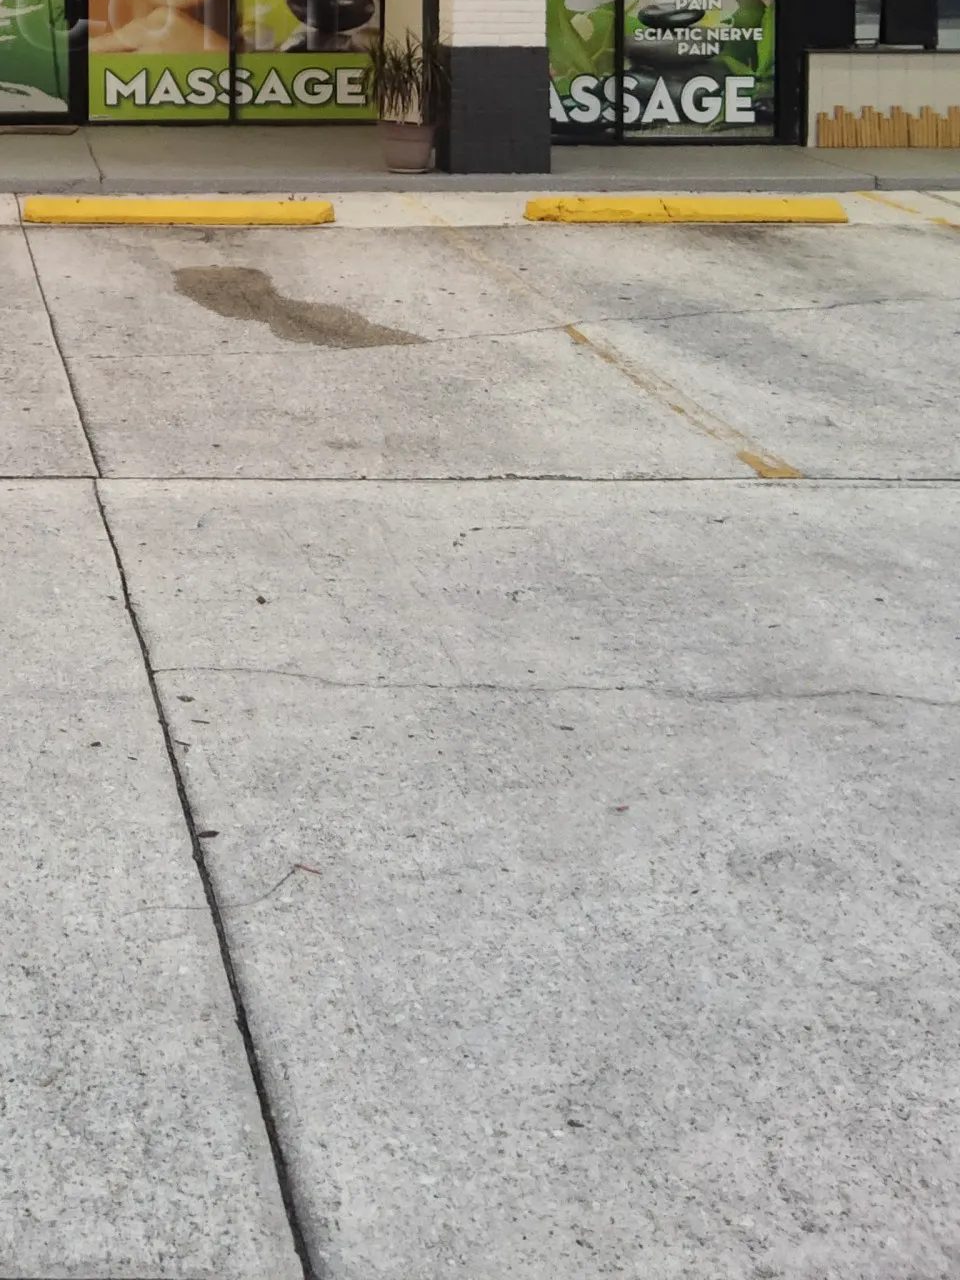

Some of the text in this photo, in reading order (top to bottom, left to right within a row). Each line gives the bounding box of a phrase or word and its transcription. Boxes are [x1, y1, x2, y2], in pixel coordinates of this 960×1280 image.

[634, 27, 764, 41] SCIATIC NERVE
[677, 42, 720, 56] PAIN
[104, 67, 367, 107] MASSAGE
